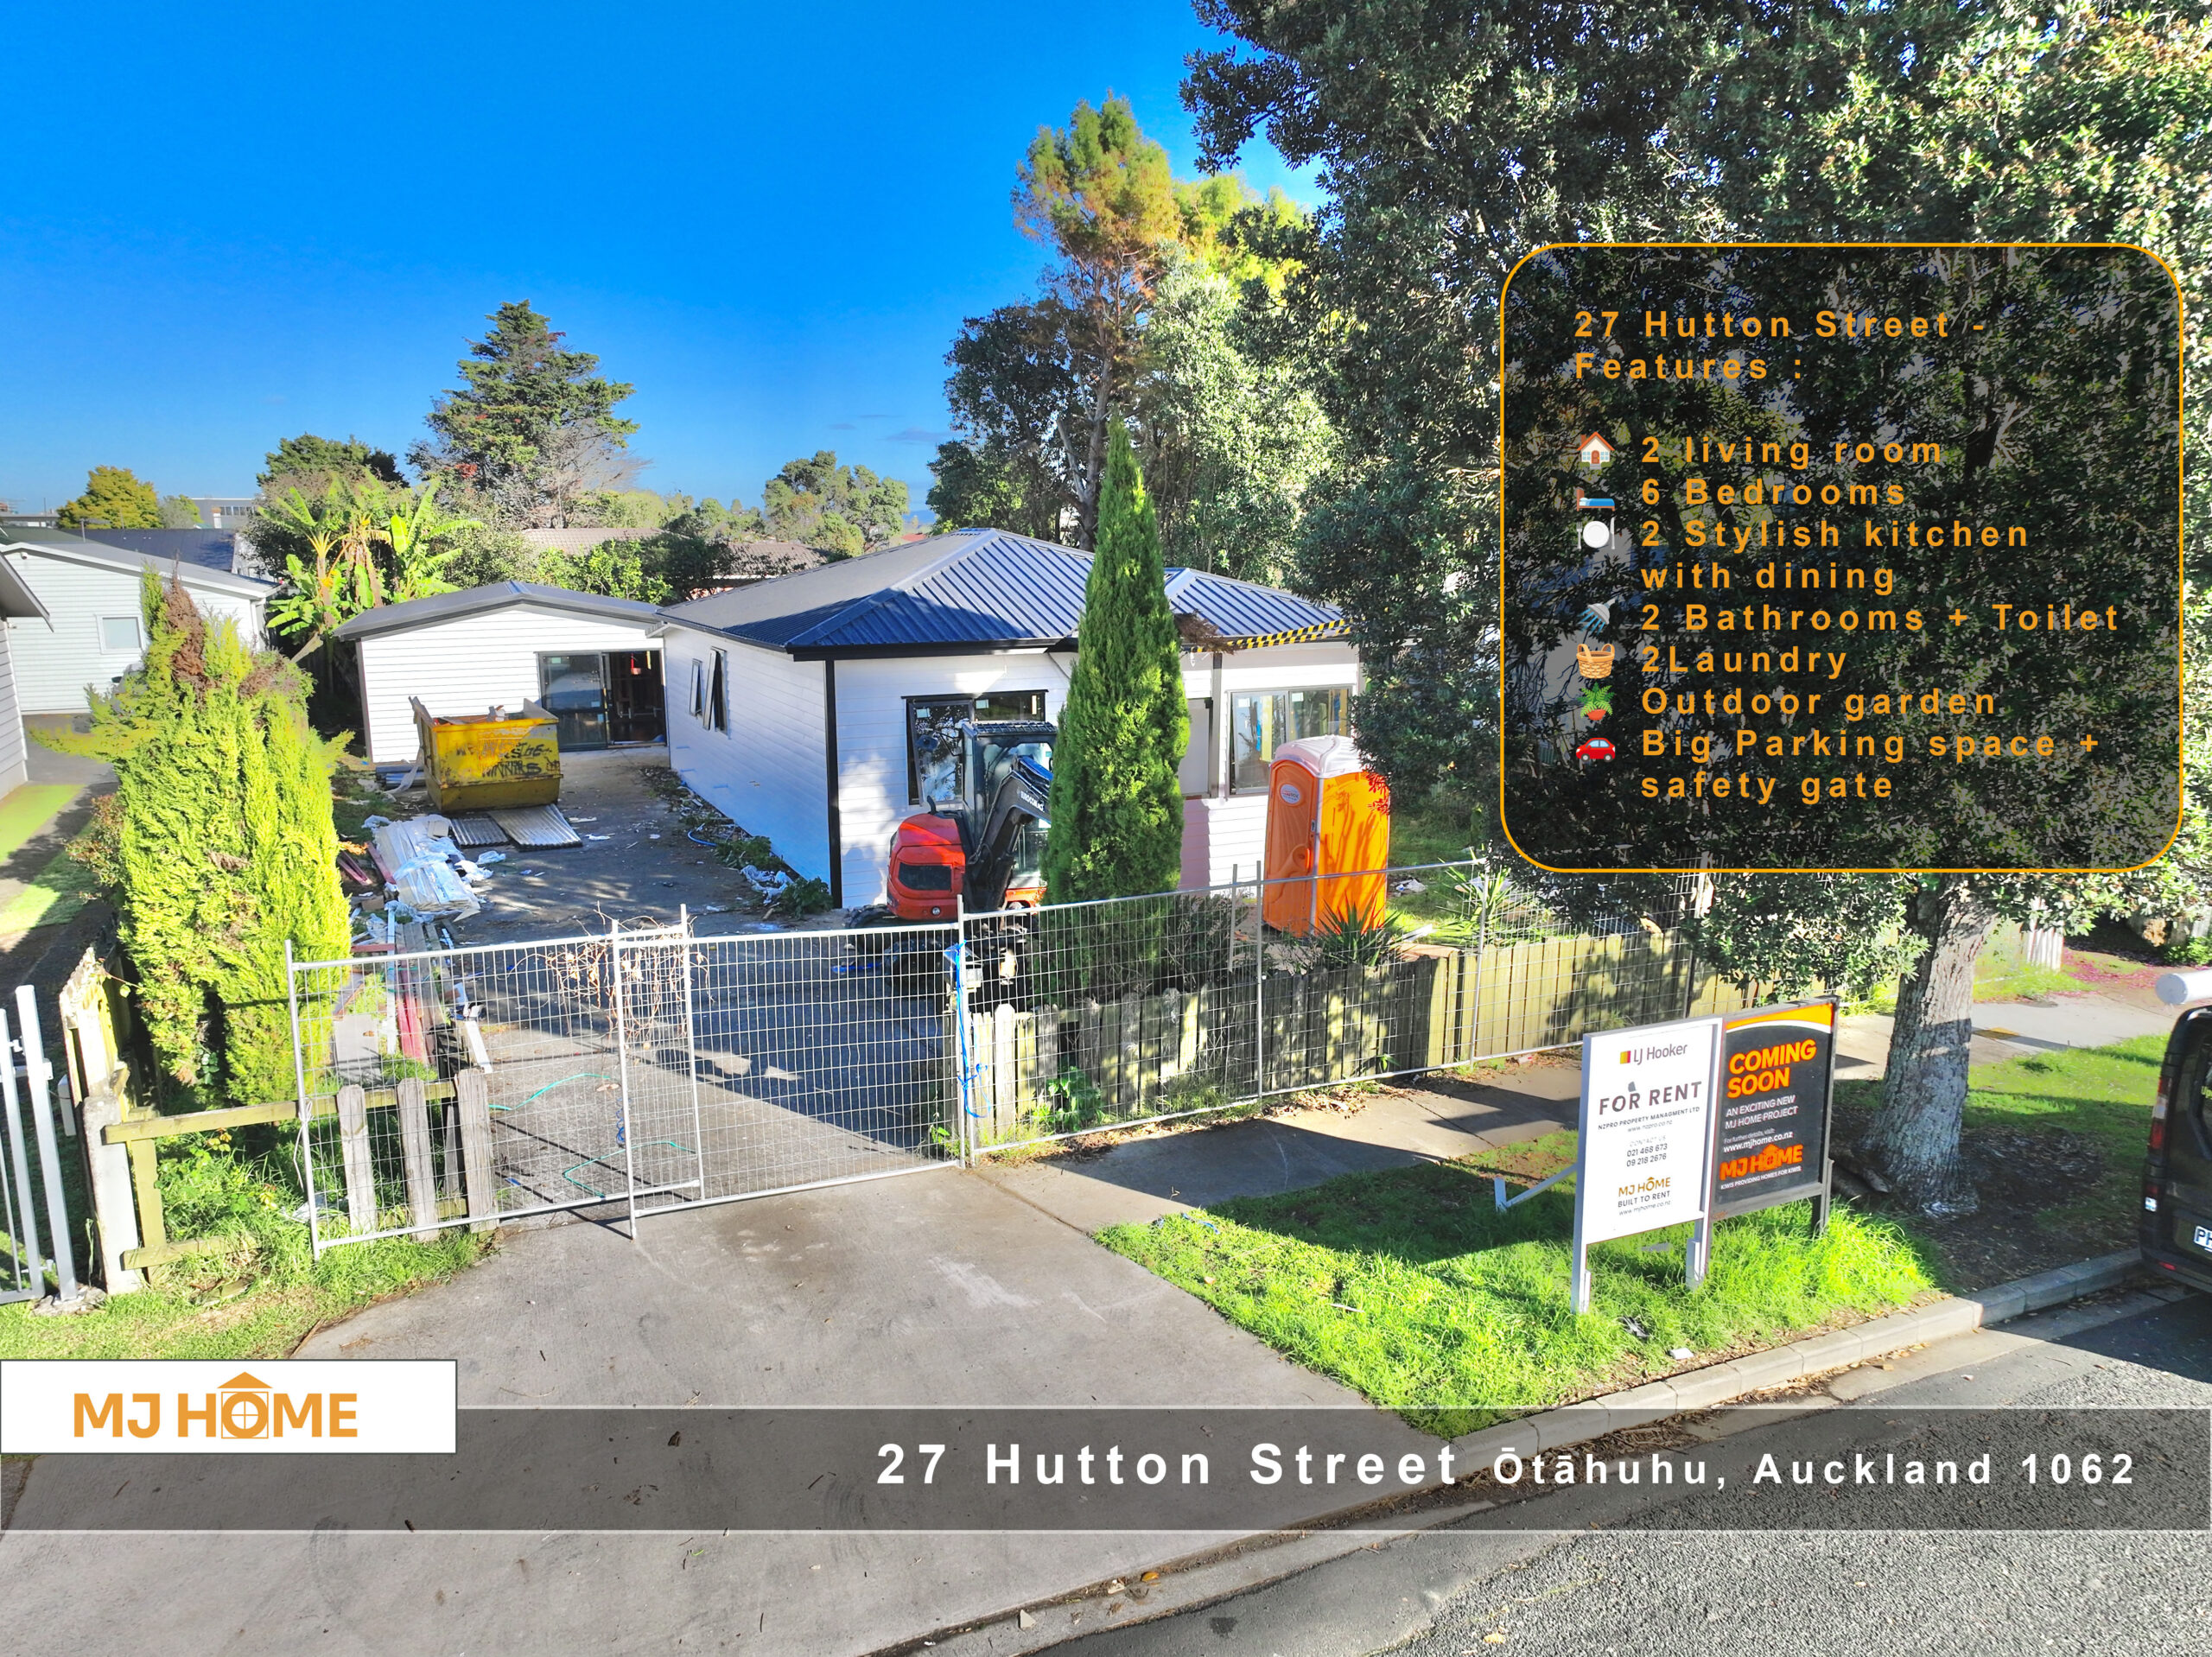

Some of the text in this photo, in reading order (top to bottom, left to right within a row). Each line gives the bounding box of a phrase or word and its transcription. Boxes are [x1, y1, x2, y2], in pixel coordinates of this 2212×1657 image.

[1633, 1044, 1688, 1065] LJ Hooker
[1729, 1038, 1817, 1075] COMING
[1726, 1067, 1790, 1098] SOON
[1599, 1081, 1702, 1115] FOR RENT
[1726, 1095, 1796, 1118] AN EXCITING NEW
[1598, 1121, 1618, 1130] NZPRO
[1619, 1116, 1649, 1127] PROPERTY
[1650, 1108, 1688, 1120] MANAGMENT
[1725, 1106, 1798, 1129] MJ HOME PROJECT
[1627, 1148, 1638, 1157] 021
[1655, 1143, 1668, 1152] 673
[1724, 1131, 1794, 1152] www.mjhome.co.nz
[1626, 1159, 1636, 1167] 09
[1649, 1153, 1667, 1163] 2676
[1719, 1144, 1803, 1181] MJ HOME
[1618, 1177, 1671, 1197] MJ HOME
[1735, 1175, 1760, 1187] PROVIDING
[1761, 1171, 1777, 1180] HOMES
[1618, 1197, 1638, 1208] BUILT
[1652, 1190, 1671, 1200] RENT
